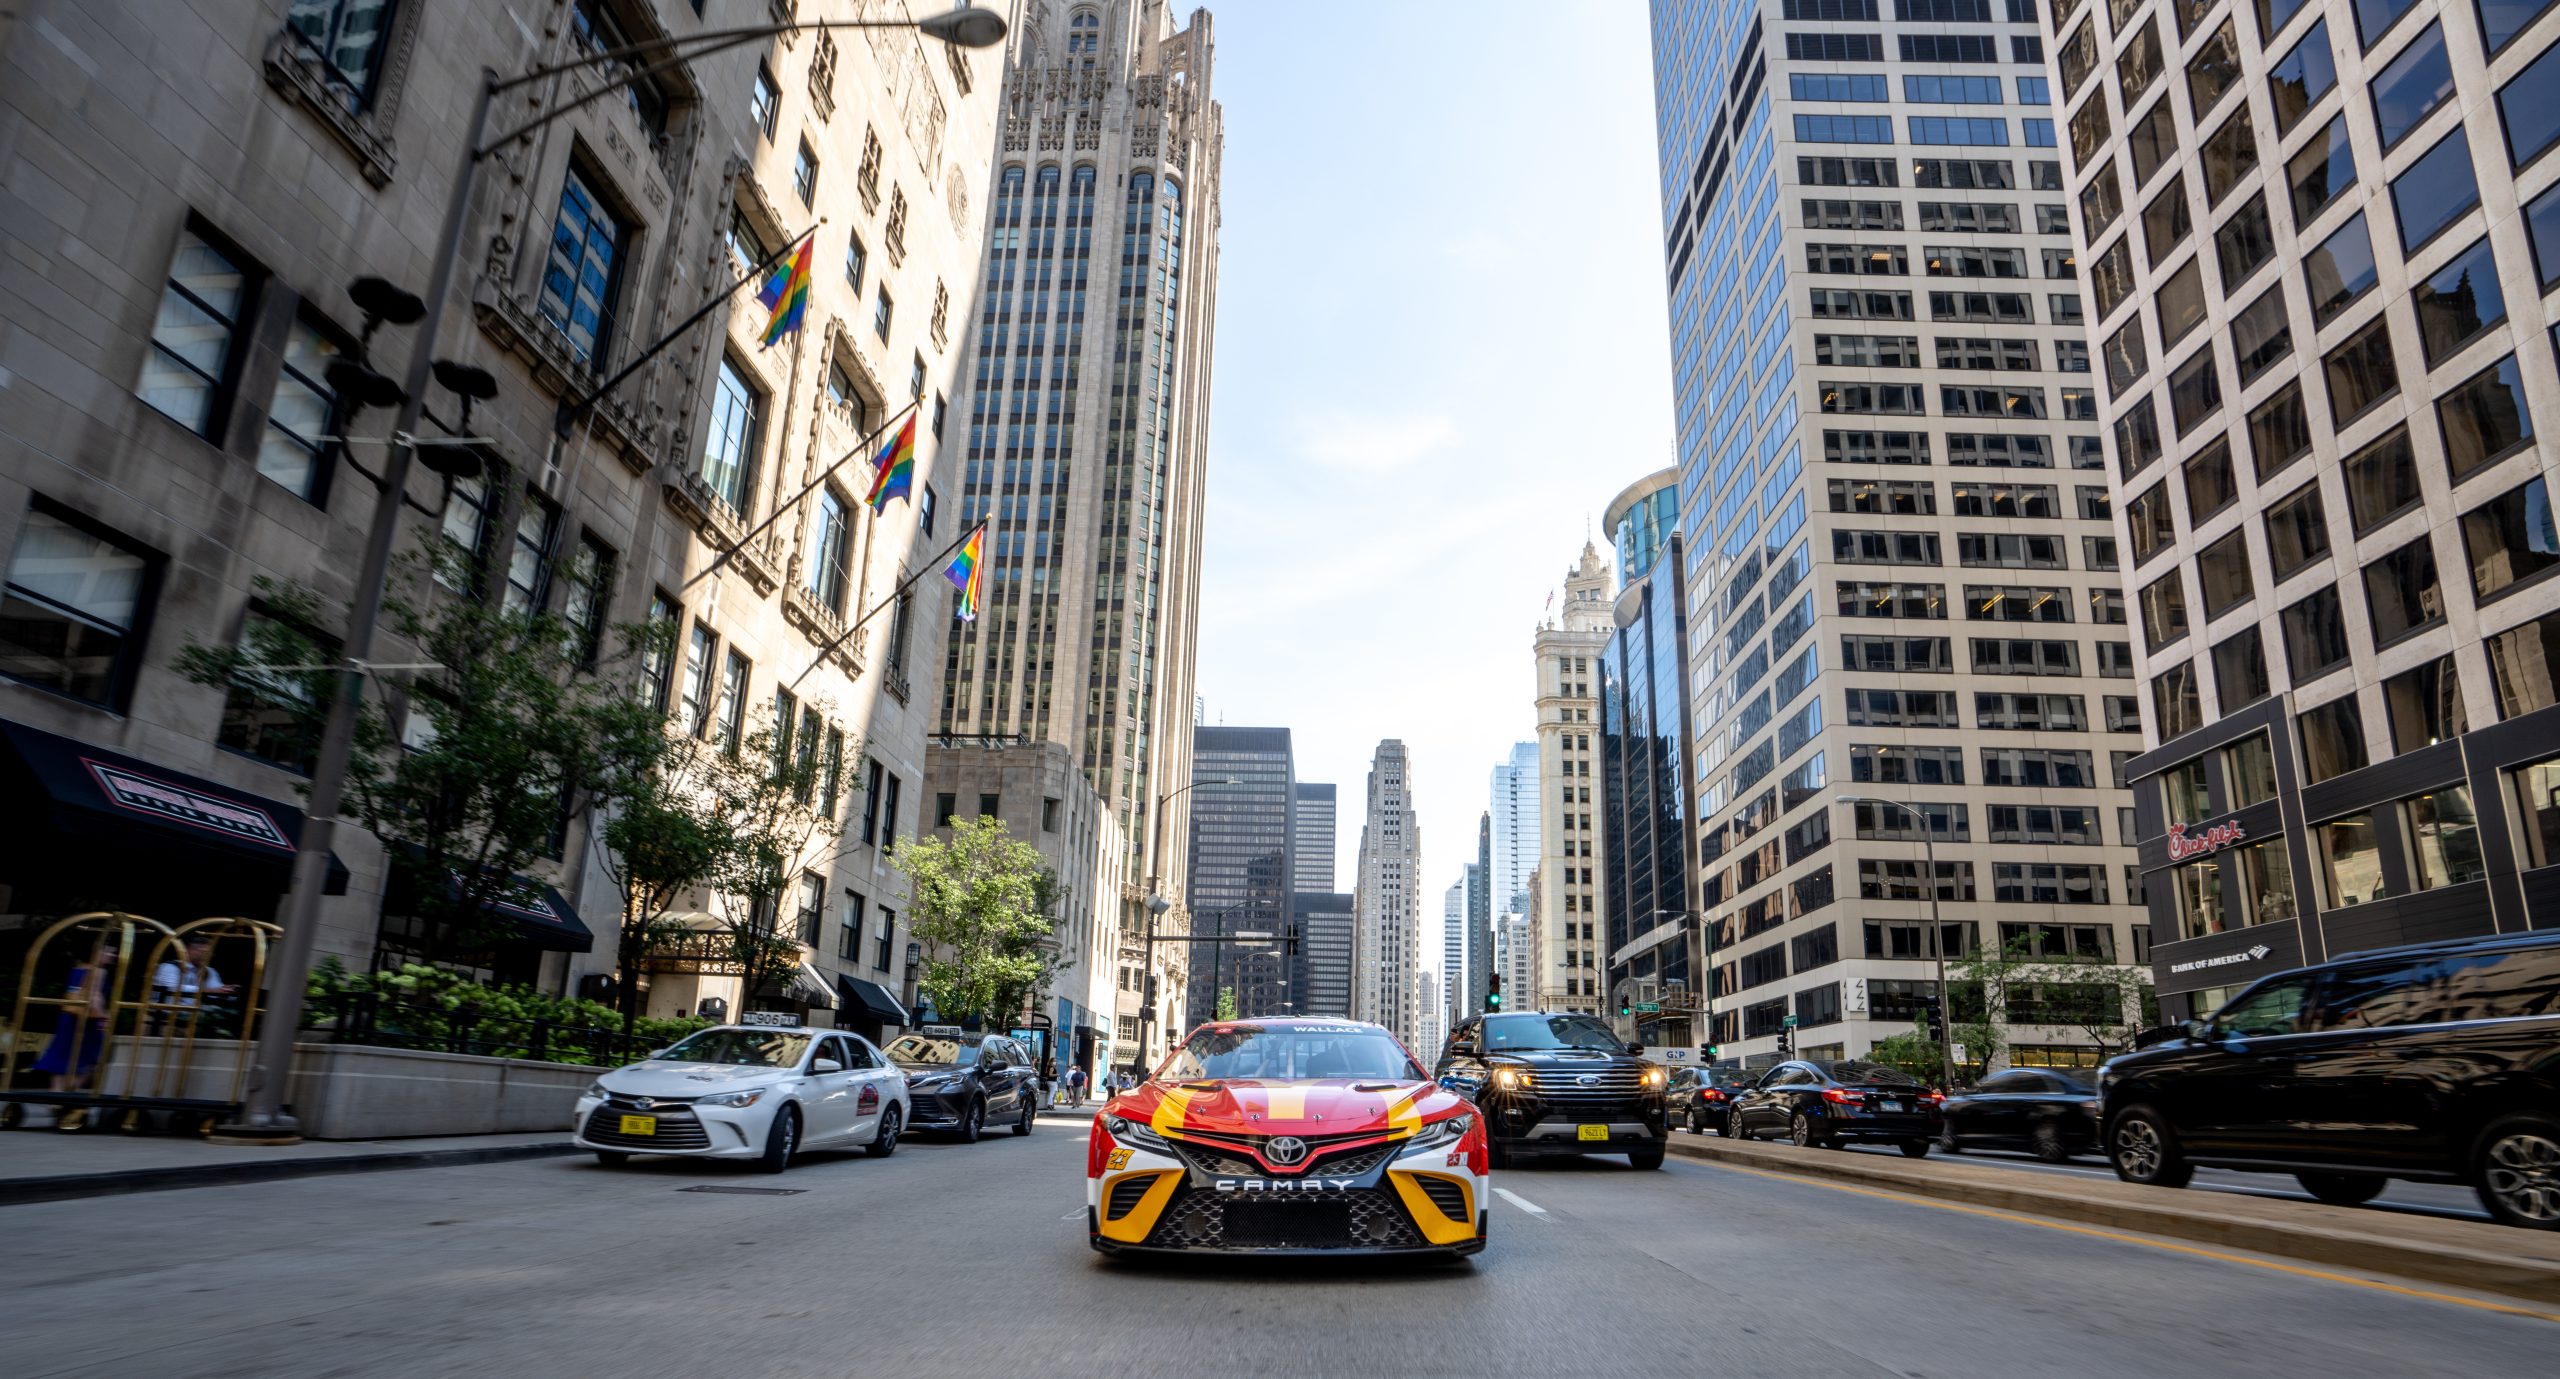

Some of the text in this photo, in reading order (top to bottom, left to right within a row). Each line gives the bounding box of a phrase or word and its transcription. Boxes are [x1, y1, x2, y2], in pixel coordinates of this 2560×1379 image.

[2171, 952, 2250, 974] BANK OF AMERICA
[756, 1013, 780, 1025] 906
[1293, 1025, 1364, 1033] WALLACE
[1215, 1180, 1354, 1191] CAMRY
